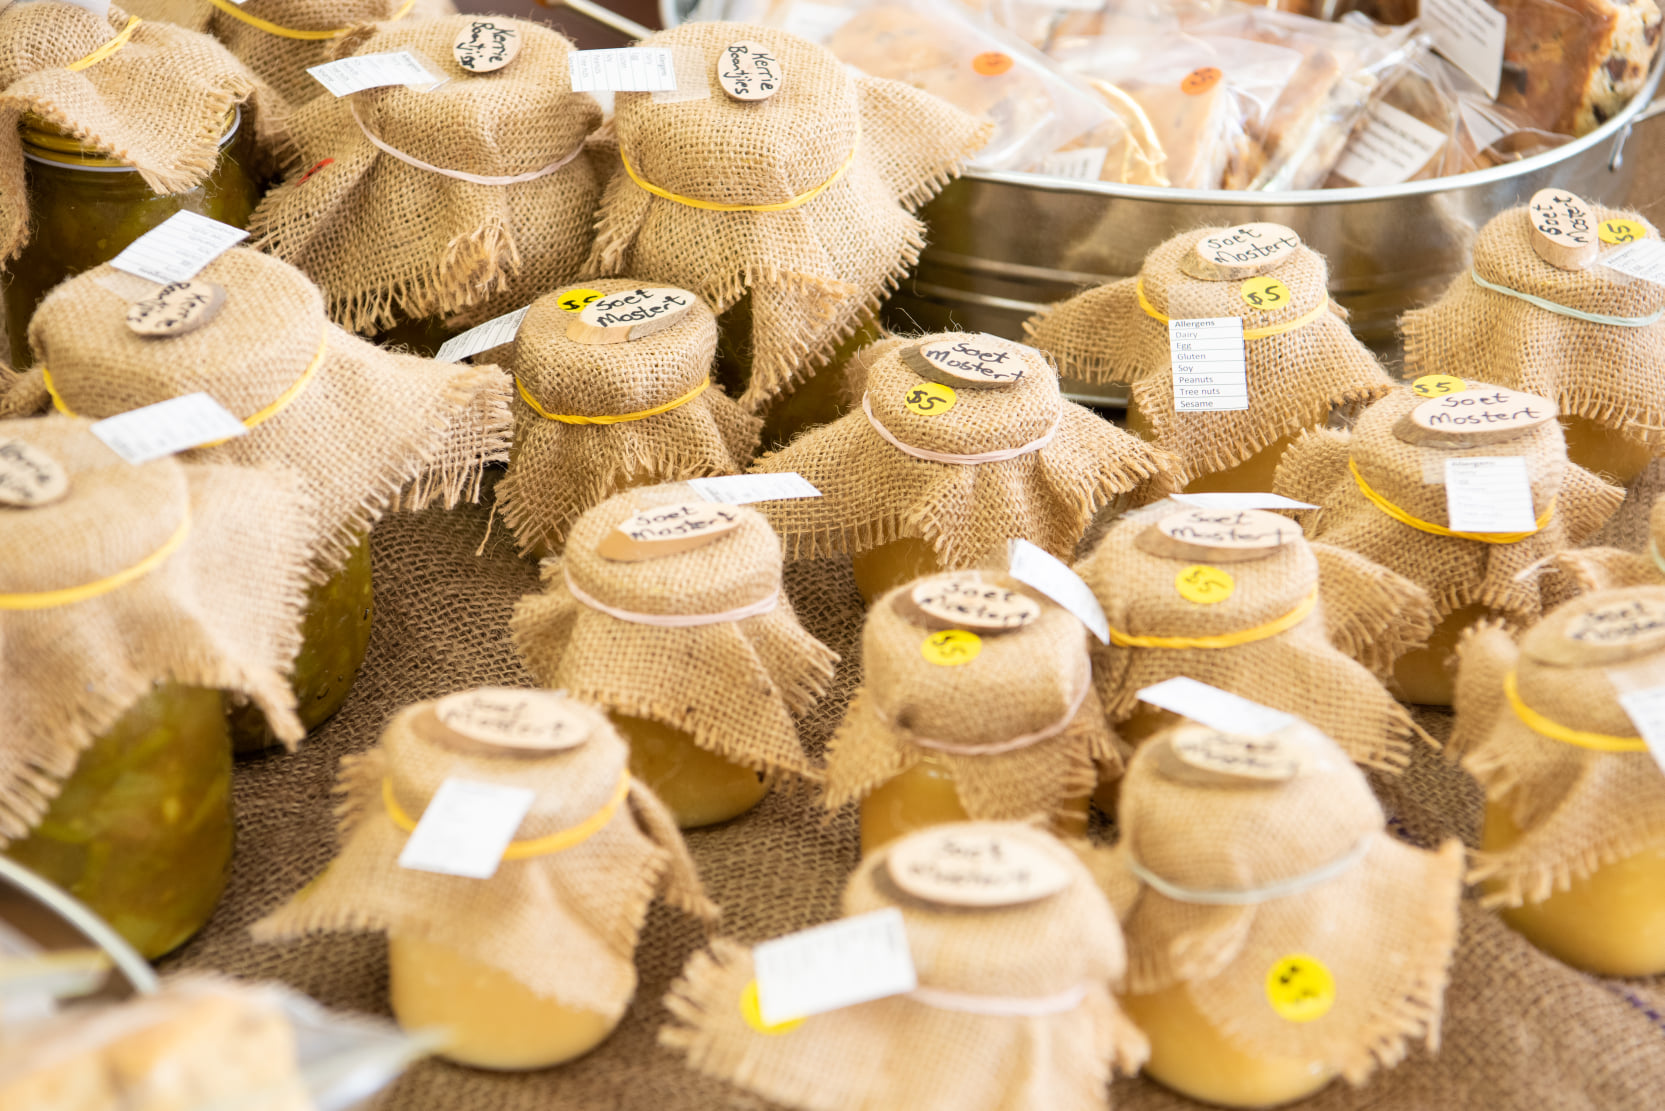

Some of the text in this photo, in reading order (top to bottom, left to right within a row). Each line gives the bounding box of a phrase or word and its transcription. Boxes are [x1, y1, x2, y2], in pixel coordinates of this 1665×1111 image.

[751, 53, 778, 91] Kerrie
[1532, 203, 1562, 236] Soet
[1207, 228, 1262, 249] Soet
[1214, 237, 1297, 263] Mostert
[595, 289, 654, 312] Soet
[1247, 285, 1280, 306] $5
[596, 295, 686, 328] Mostert
[1174, 320, 1215, 328] Allergens
[1175, 331, 1198, 339] Dairy
[951, 342, 1010, 364] Soet
[1176, 342, 1192, 351] Egg
[925, 350, 1026, 381] Mostert
[1177, 353, 1206, 361] Gluten
[1178, 364, 1194, 373] Soy
[1179, 376, 1214, 384] Peanuts
[906, 389, 947, 410] $5
[1180, 387, 1221, 396] Tree nuts
[1440, 392, 1510, 407] Soet
[1180, 400, 1214, 408] Sesame
[1429, 407, 1542, 426] Mostert
